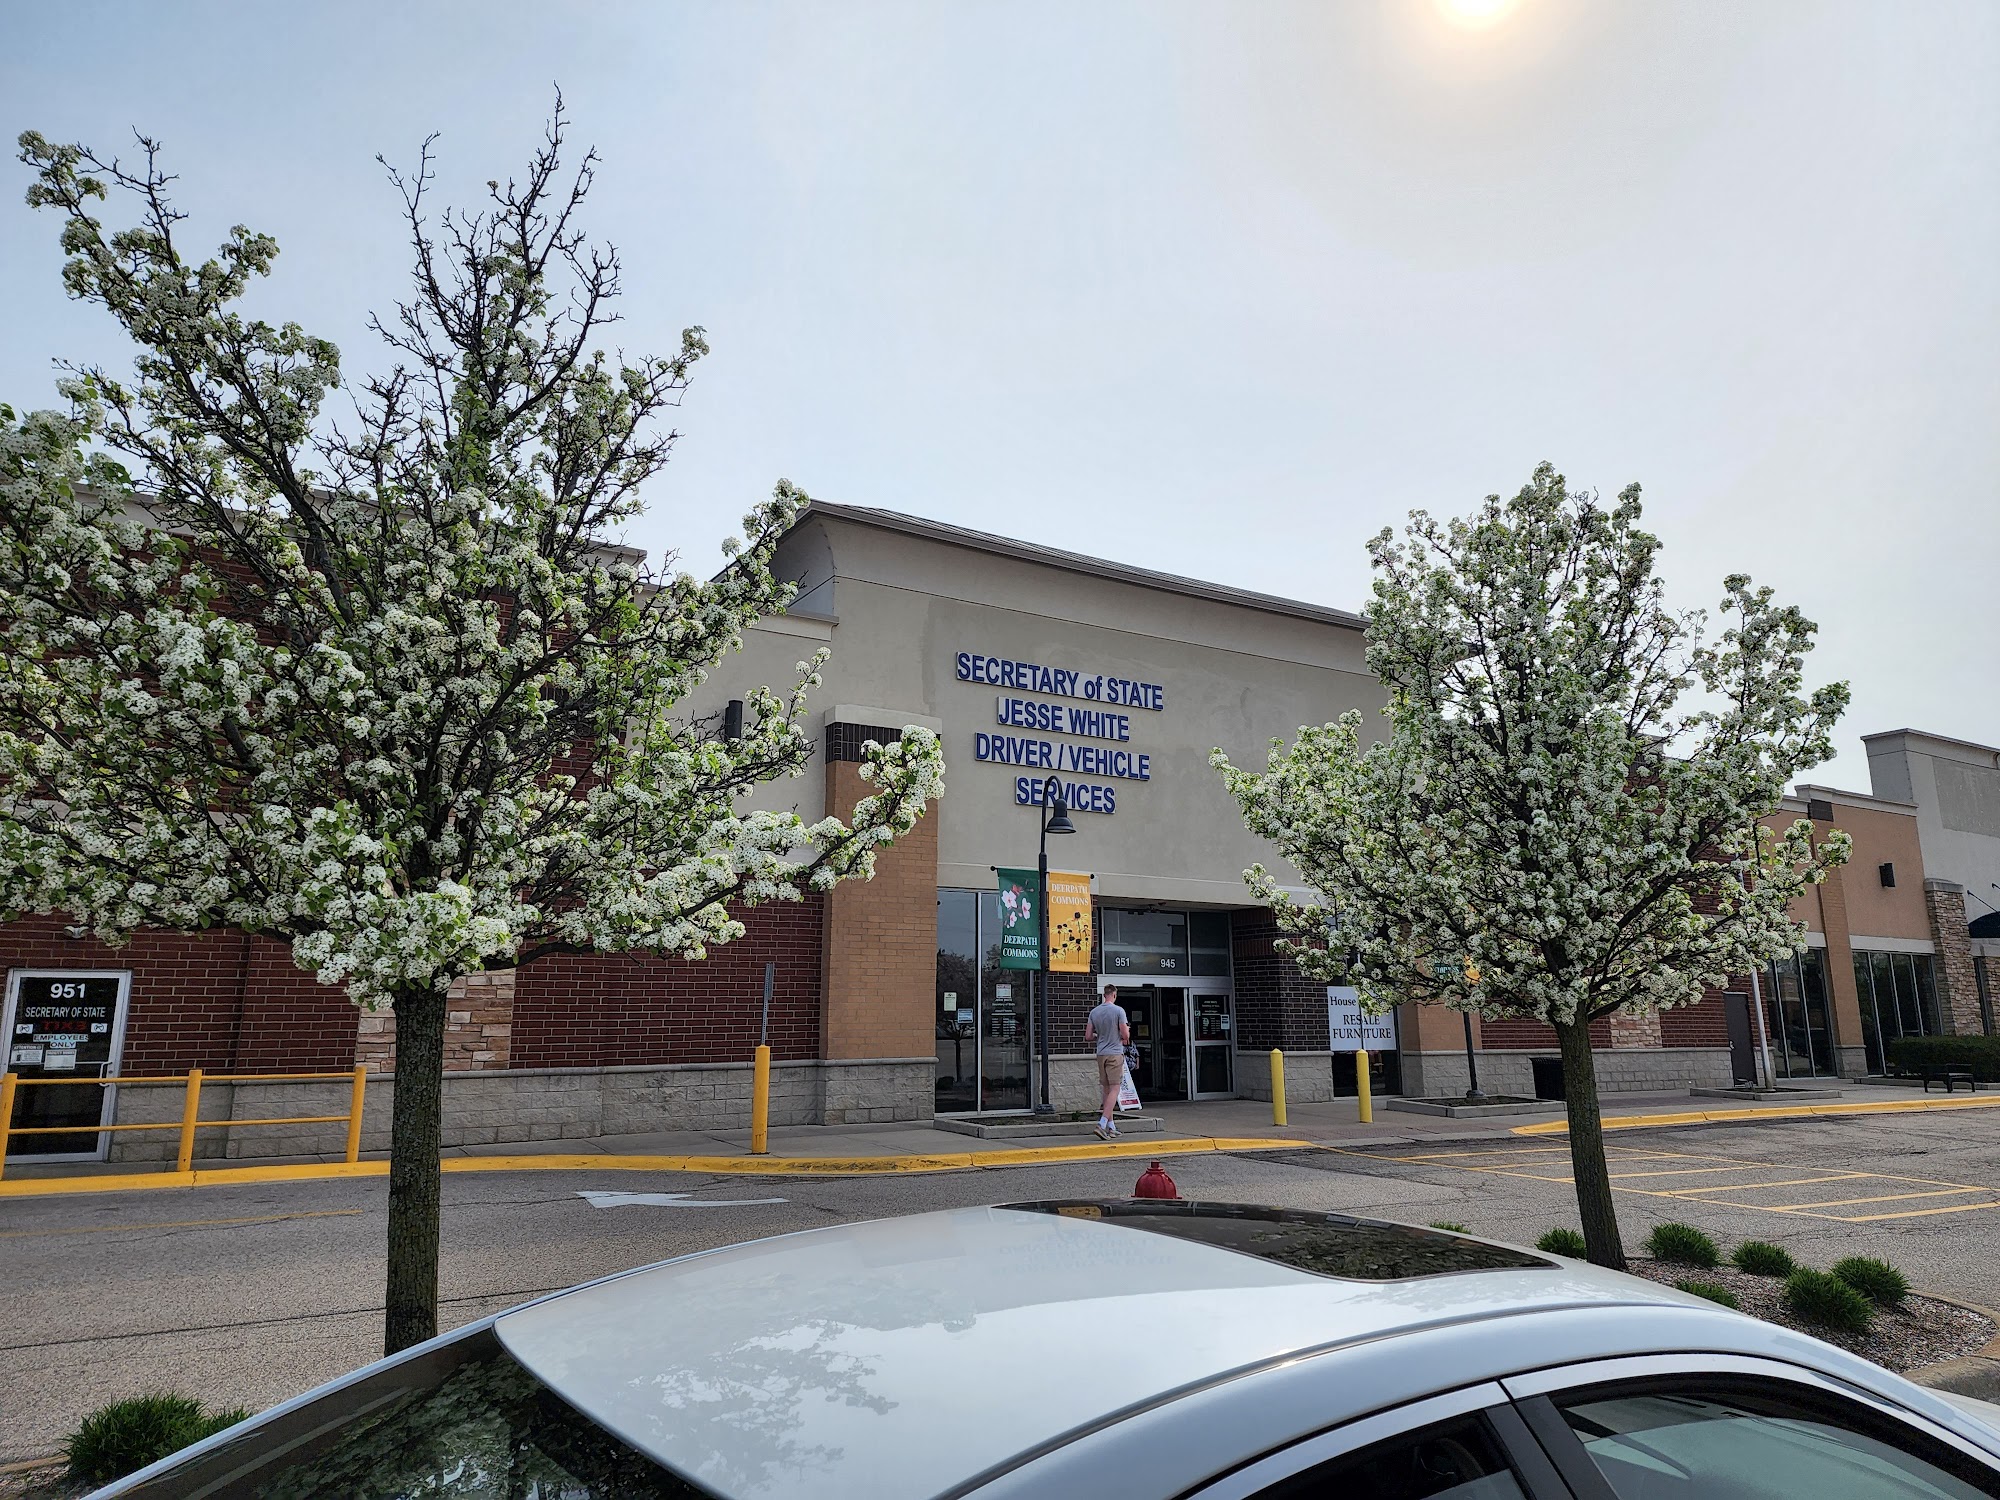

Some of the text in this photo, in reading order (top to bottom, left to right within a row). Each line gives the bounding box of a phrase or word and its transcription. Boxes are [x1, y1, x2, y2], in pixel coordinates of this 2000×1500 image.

[957, 652, 1164, 710] SECRETARY of STATE
[998, 698, 1130, 741] JESSE WHITE
[976, 732, 1053, 769] DRIVER
[1068, 745, 1150, 780] VEHICLE
[1016, 777, 1116, 814] SERVICES
[1051, 883, 1088, 894] DEERPATH
[1051, 896, 1089, 906] COMMONS
[1004, 935, 1038, 946] DEERPATH
[1002, 947, 1039, 958] COMMONS
[1115, 957, 1130, 967] 951
[1160, 958, 1176, 969] 945
[50, 983, 86, 999] 951
[1329, 996, 1357, 1006] House
[25, 1006, 106, 1018] SECRETARY OF STATE
[1343, 1014, 1381, 1026] RESALE
[1332, 1028, 1392, 1039] FURNITURE
